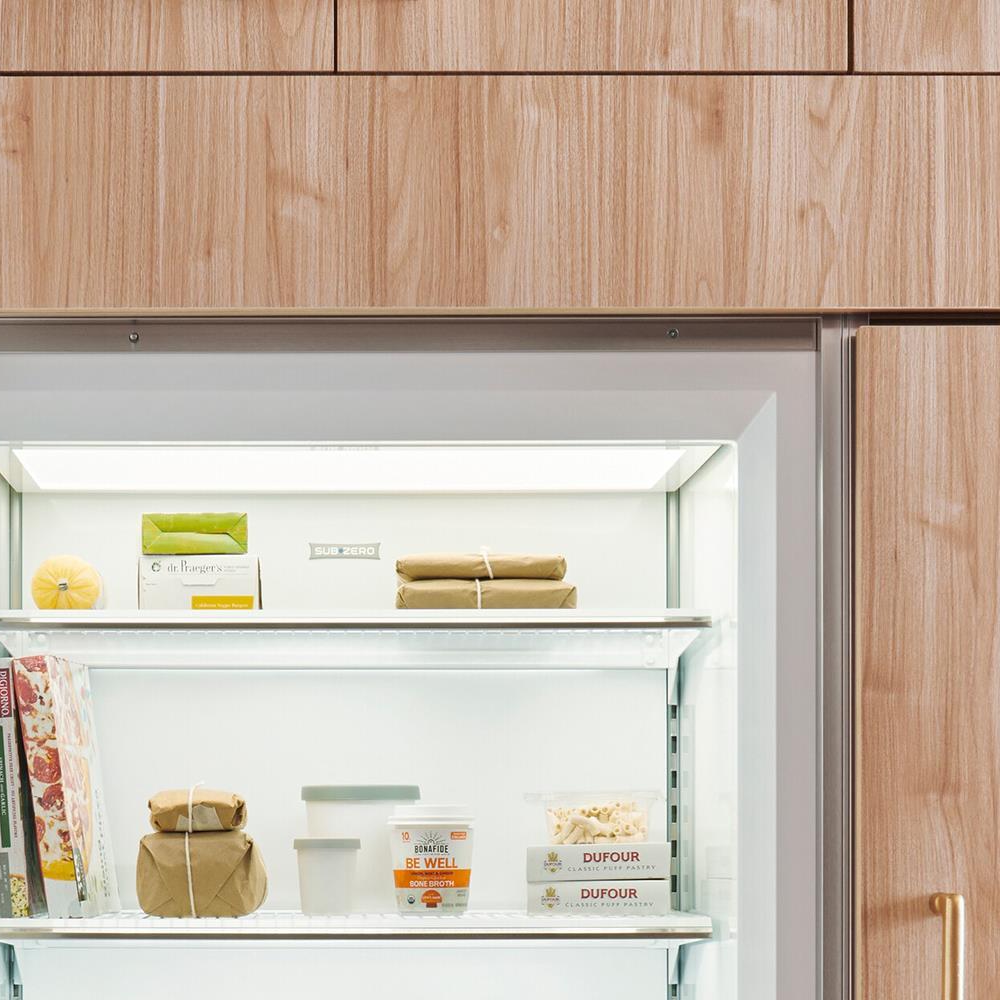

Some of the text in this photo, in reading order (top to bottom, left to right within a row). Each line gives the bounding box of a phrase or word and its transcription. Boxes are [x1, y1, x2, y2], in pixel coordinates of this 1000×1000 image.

[314, 546, 375, 555] SUB ZERO
[0, 670, 11, 718] DIGIORNO
[414, 844, 449, 853] BONAFIDE
[583, 851, 640, 863] DUFOUR
[405, 857, 458, 869] BE WELL
[409, 880, 455, 888] BONE BROTH
[580, 888, 638, 899] DUFOUR
